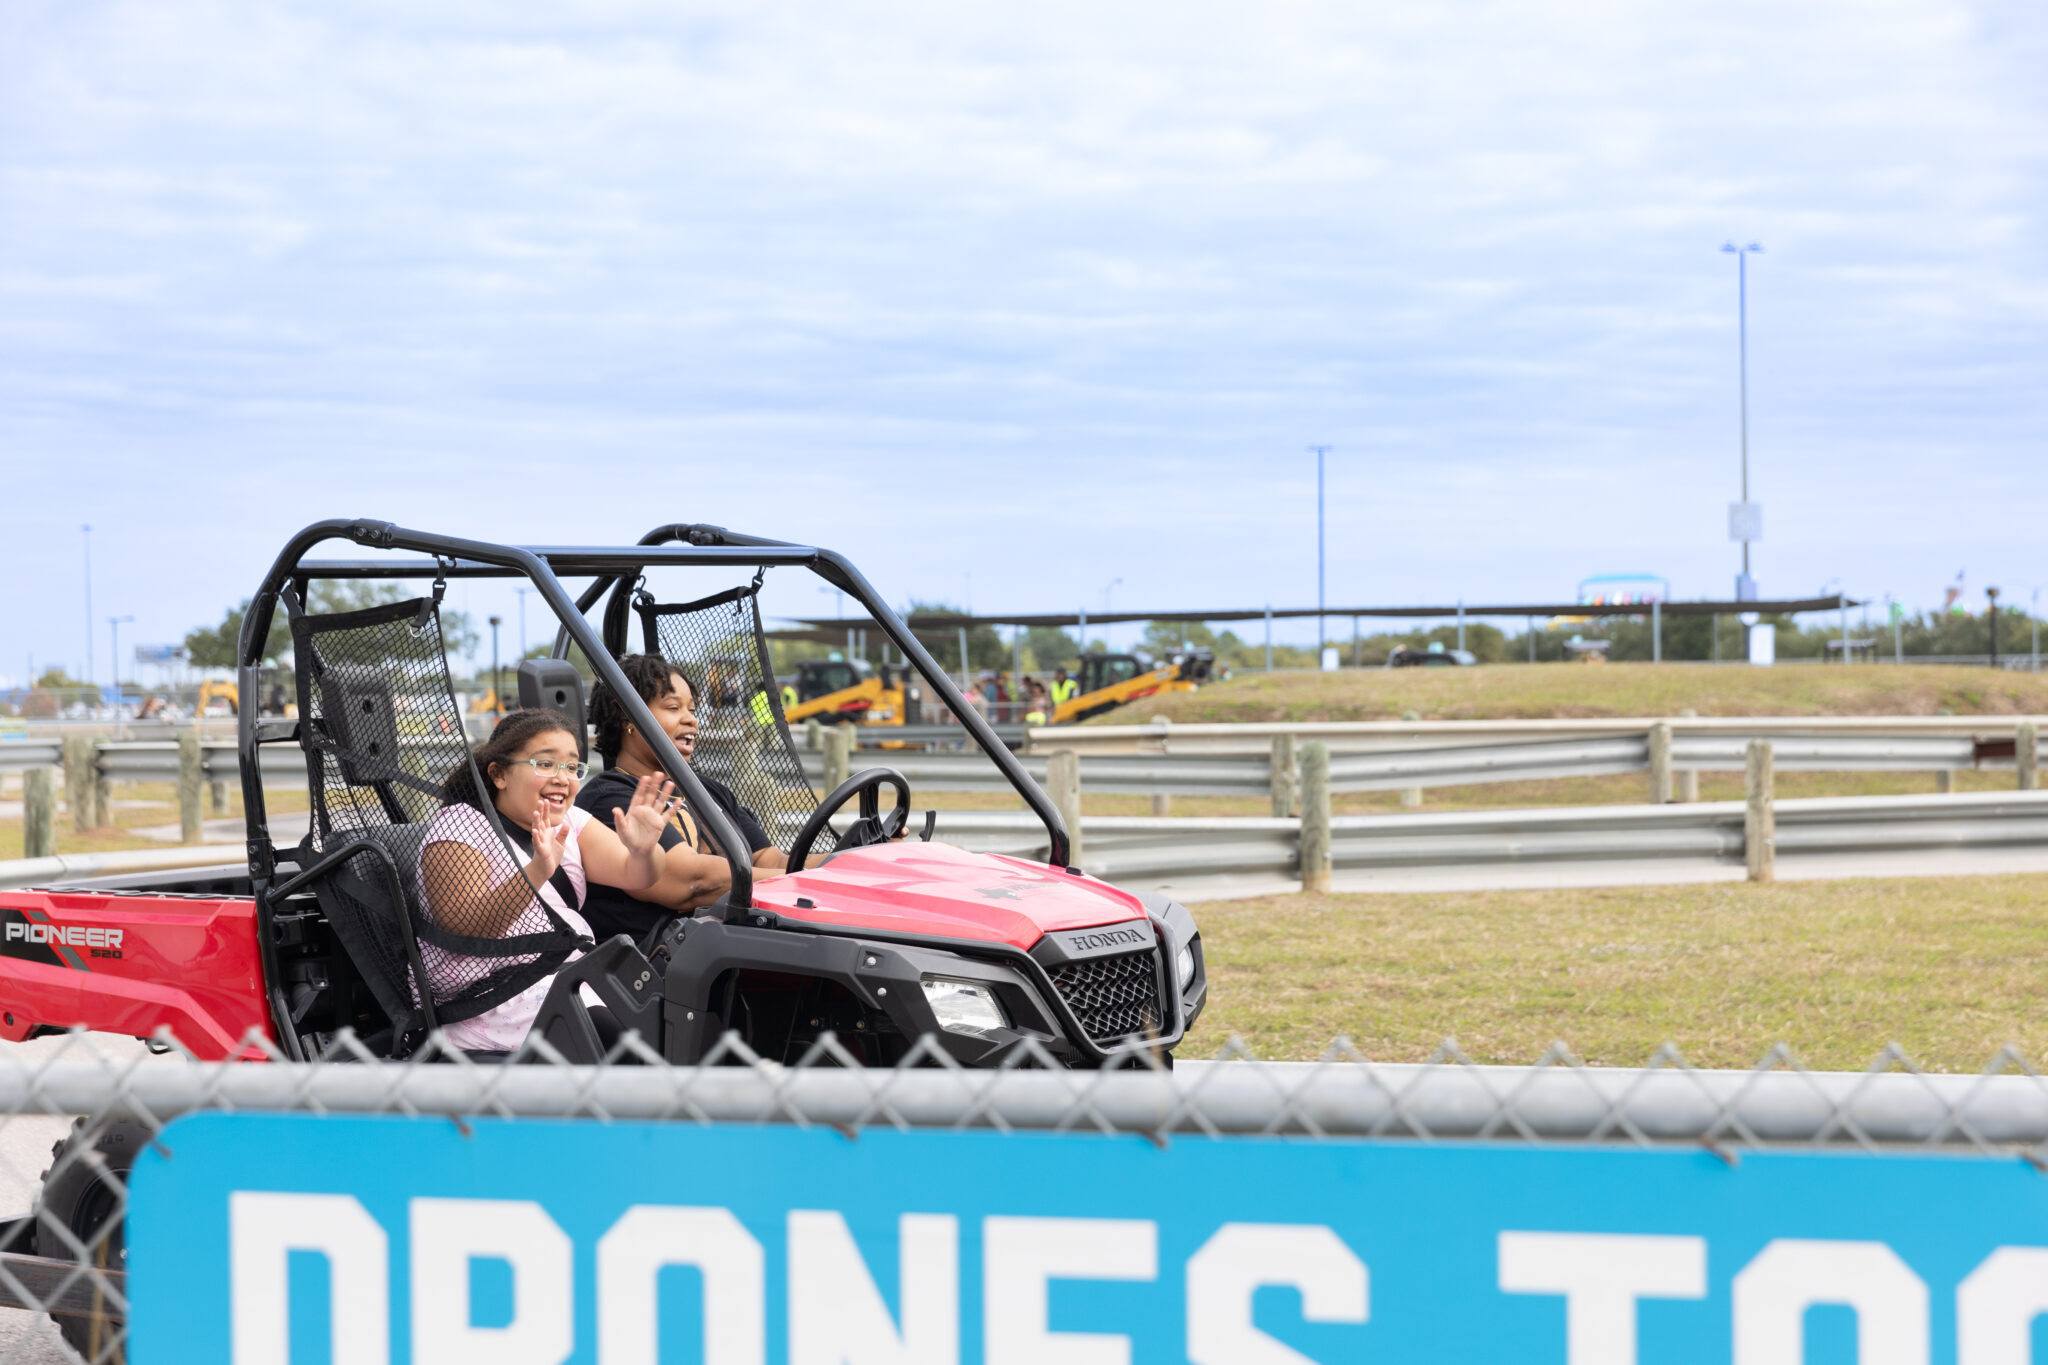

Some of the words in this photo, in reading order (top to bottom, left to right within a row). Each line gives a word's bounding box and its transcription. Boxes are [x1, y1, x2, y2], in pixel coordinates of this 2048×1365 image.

[6, 922, 123, 948] PIONEER
[1068, 928, 1147, 951] HONDA
[90, 949, 123, 959] 520
[229, 1190, 1369, 1365] DRONES
[1498, 1230, 2048, 1365] TO
